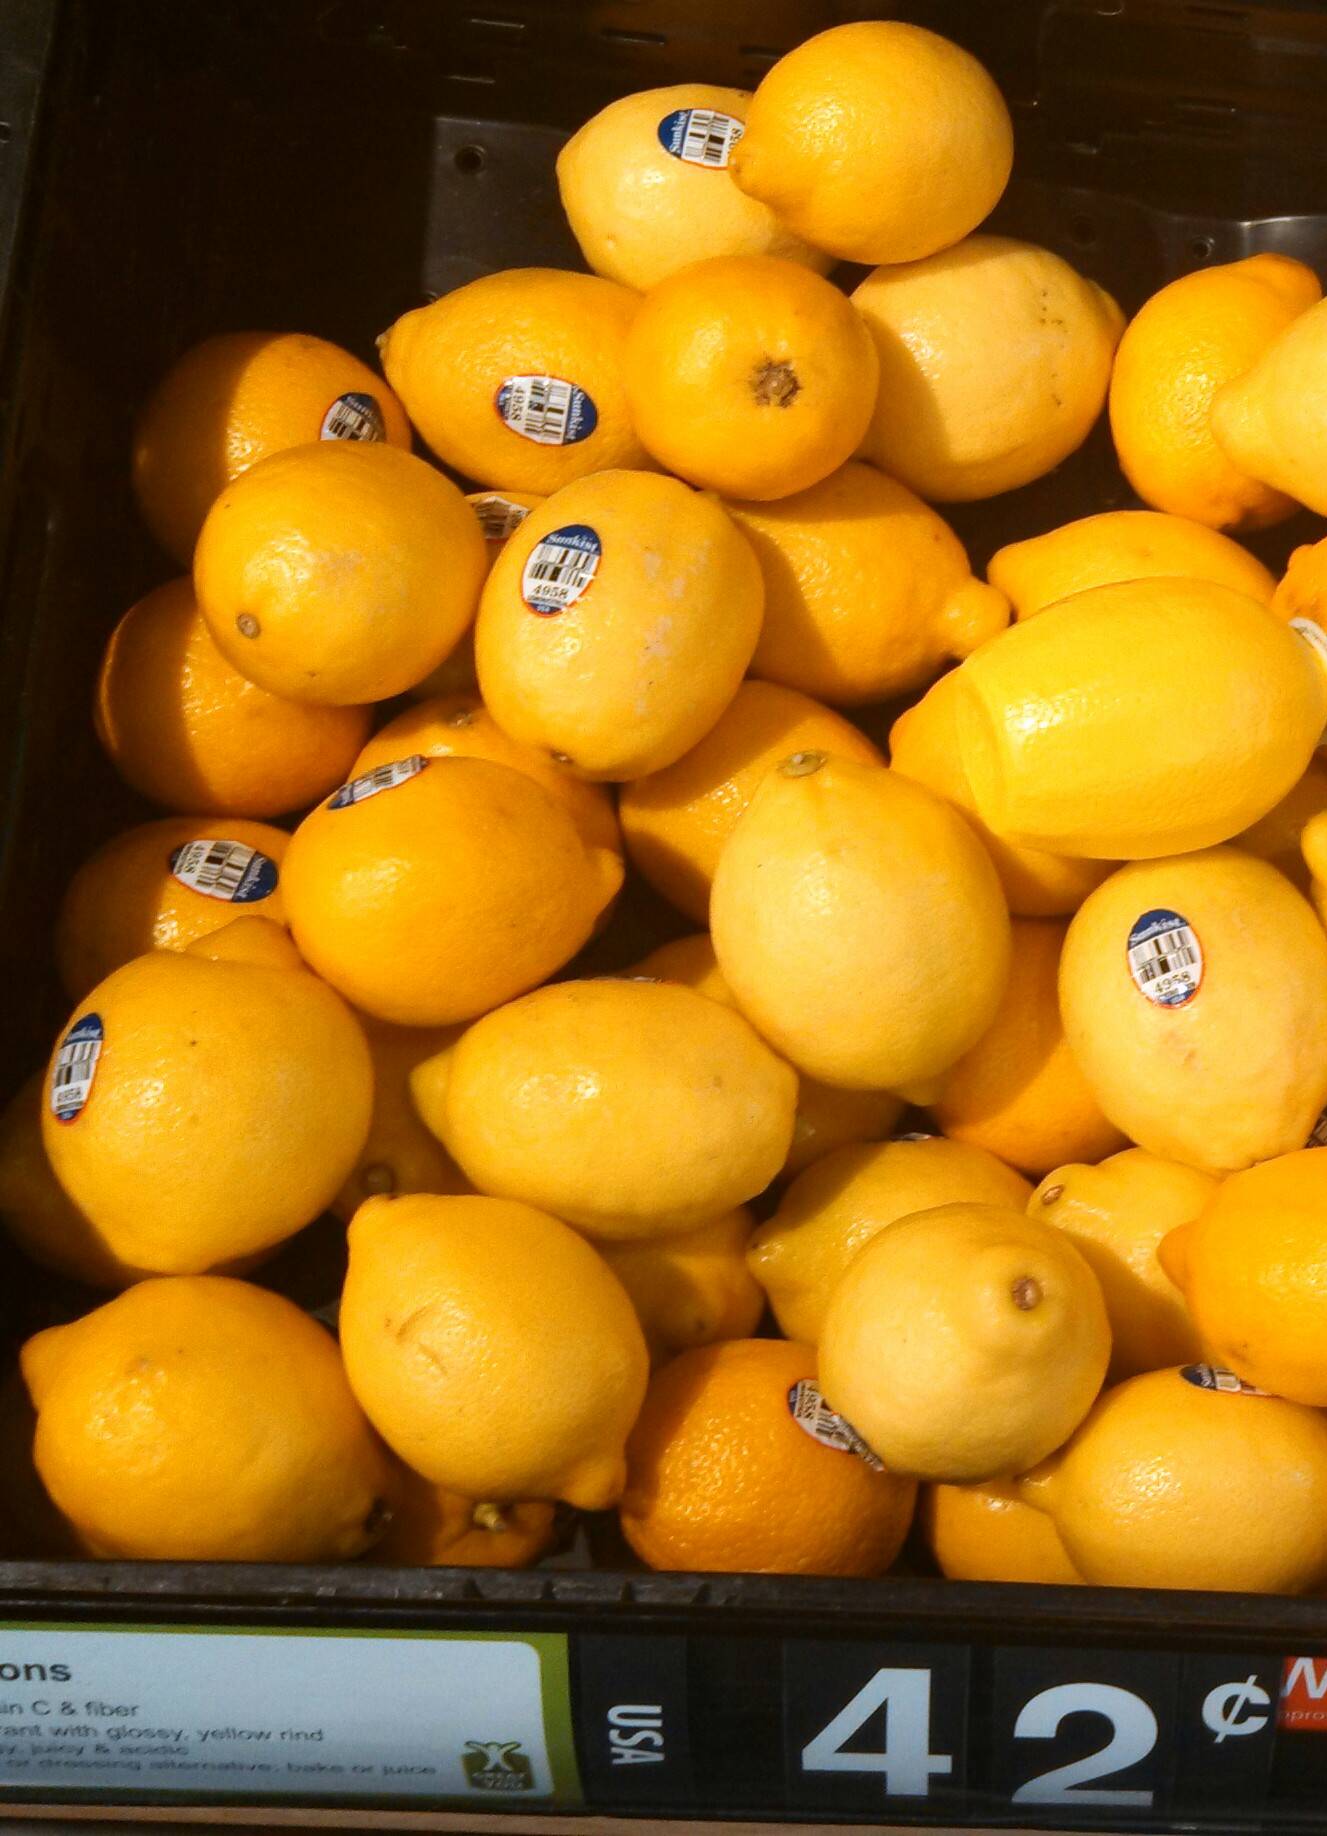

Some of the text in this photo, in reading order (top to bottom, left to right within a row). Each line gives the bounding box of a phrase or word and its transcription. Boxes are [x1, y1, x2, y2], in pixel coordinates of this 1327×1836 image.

[669, 111, 689, 153] Sunkist
[512, 384, 525, 423] 4958
[563, 383, 587, 441] Sunkist
[547, 531, 597, 553] Sunkist
[532, 583, 568, 600] 4958
[236, 854, 267, 899] Sunkist
[1129, 916, 1183, 943] Sunkist
[31, 1700, 51, 1716] C
[61, 1701, 76, 1716] &
[85, 1701, 140, 1717] fiber
[51, 1725, 98, 1738] with
[197, 1726, 272, 1742] yellow
[280, 1728, 324, 1741] rind
[606, 1704, 665, 1766] USA
